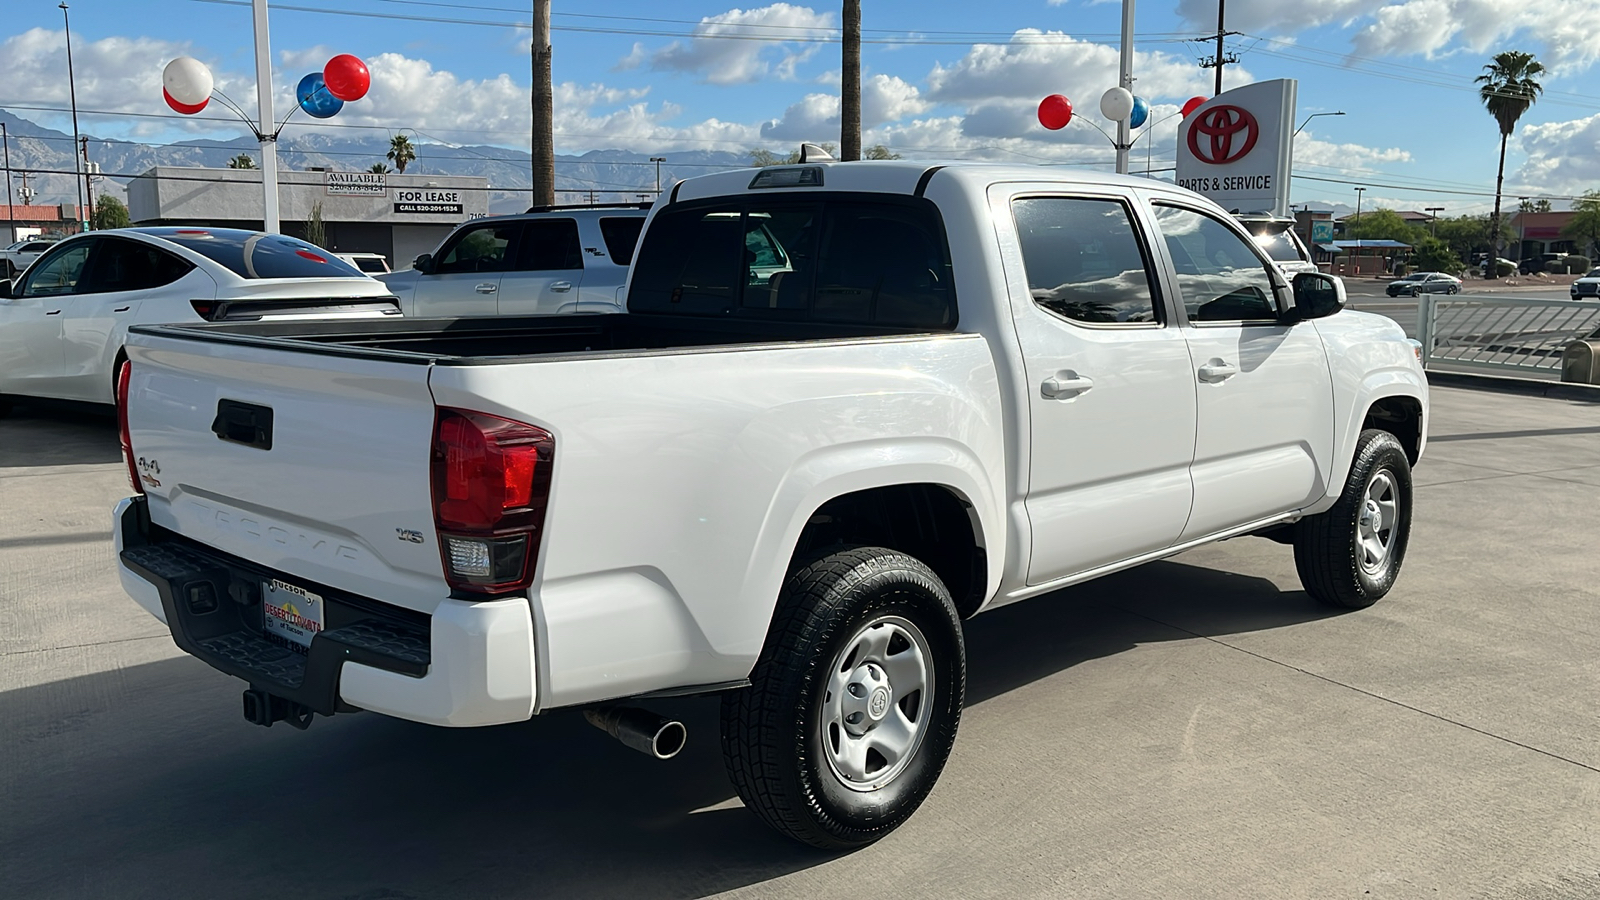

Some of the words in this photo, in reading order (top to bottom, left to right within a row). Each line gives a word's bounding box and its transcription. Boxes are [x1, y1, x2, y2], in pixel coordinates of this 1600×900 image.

[328, 173, 385, 183] AVAILABLE
[1179, 178, 1209, 192] PARTS
[1212, 177, 1220, 191] &
[1223, 175, 1271, 191] SERVICE
[399, 191, 422, 202] FOR
[425, 192, 458, 202] LEASE
[395, 527, 424, 544] V6
[273, 580, 306, 597] TUCSON
[265, 603, 290, 623] DESERT
[285, 624, 304, 637] Tucson
